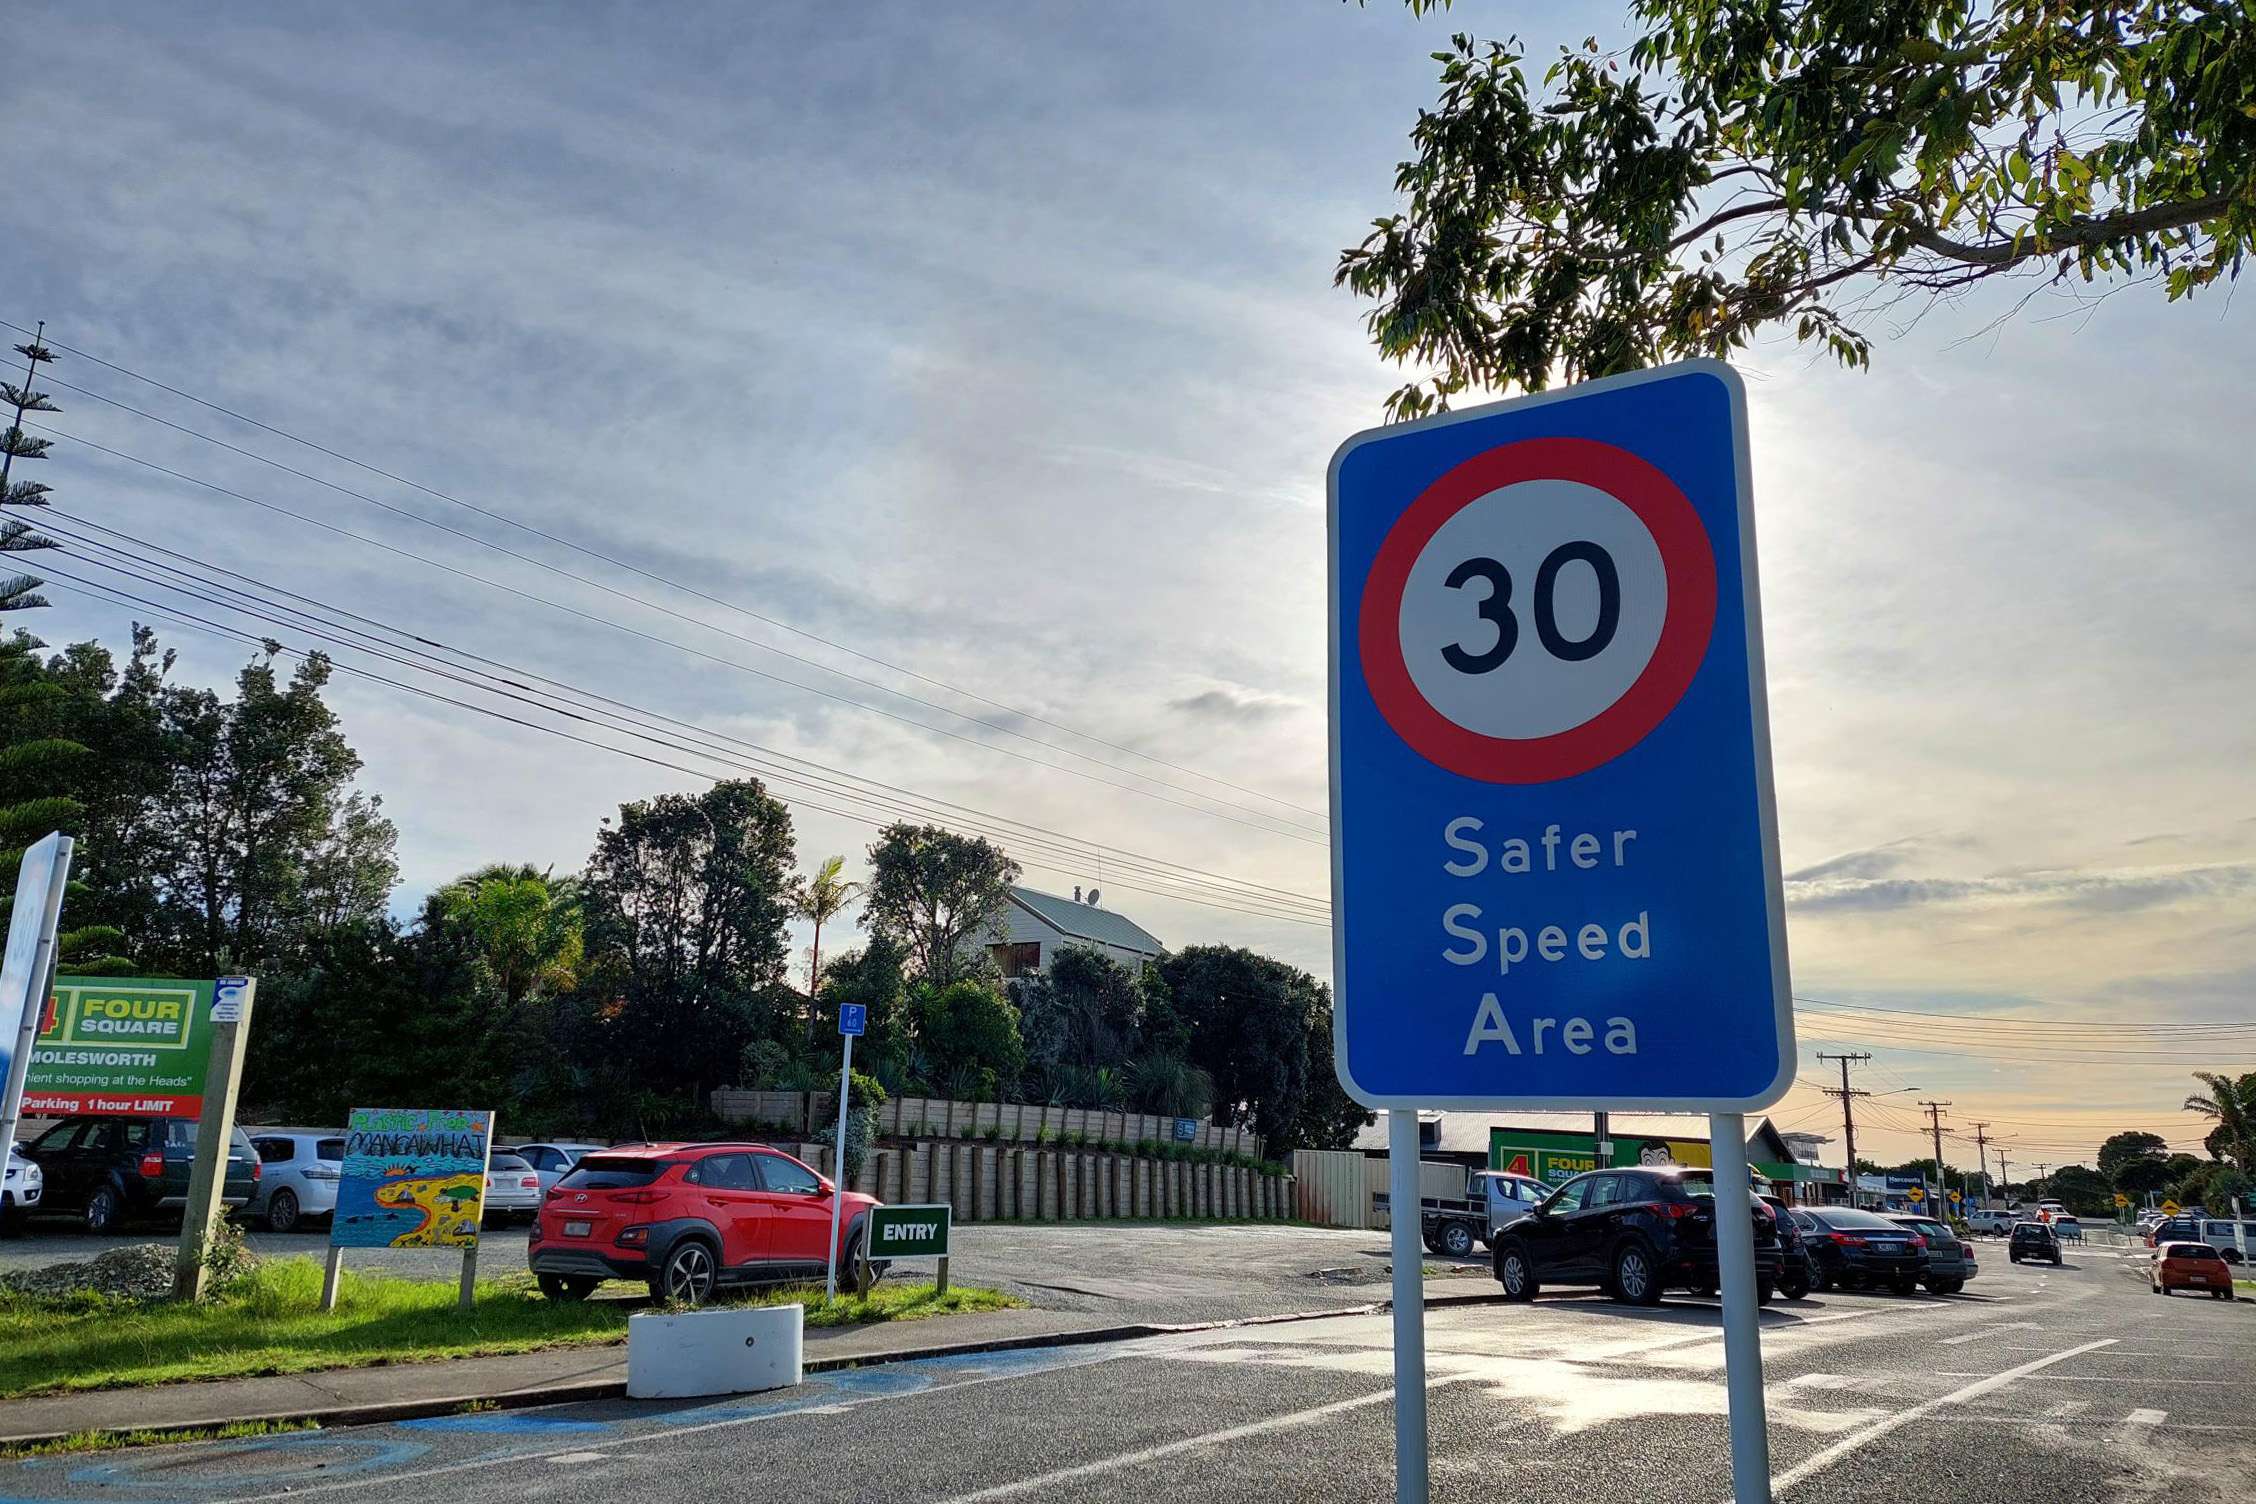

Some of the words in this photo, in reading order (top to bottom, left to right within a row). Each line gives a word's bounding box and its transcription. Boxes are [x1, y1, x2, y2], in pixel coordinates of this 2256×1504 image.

[1441, 541, 1620, 674] 30
[1443, 816, 1637, 877] Safer
[1442, 903, 1650, 976] Speed
[83, 999, 180, 1019] FOUR
[849, 1006, 857, 1017] P
[80, 1019, 178, 1034] SQUARE
[1463, 992, 1637, 1055] Area
[29, 1050, 156, 1067] MOLESWORTH
[25, 1073, 52, 1084] nient
[55, 1073, 109, 1087] shopping
[112, 1075, 124, 1085] at
[127, 1075, 146, 1086] the
[21, 1096, 79, 1112] Parking
[88, 1099, 95, 1110] 1
[96, 1099, 132, 1111] hour
[133, 1100, 174, 1112] LIMIT
[1506, 1155, 1532, 1177] 4
[1547, 1157, 1596, 1171] FOUR
[1548, 1169, 1581, 1178] SQUA
[1888, 1176, 1921, 1184] Harcourts
[883, 1223, 938, 1241] ENTRY
